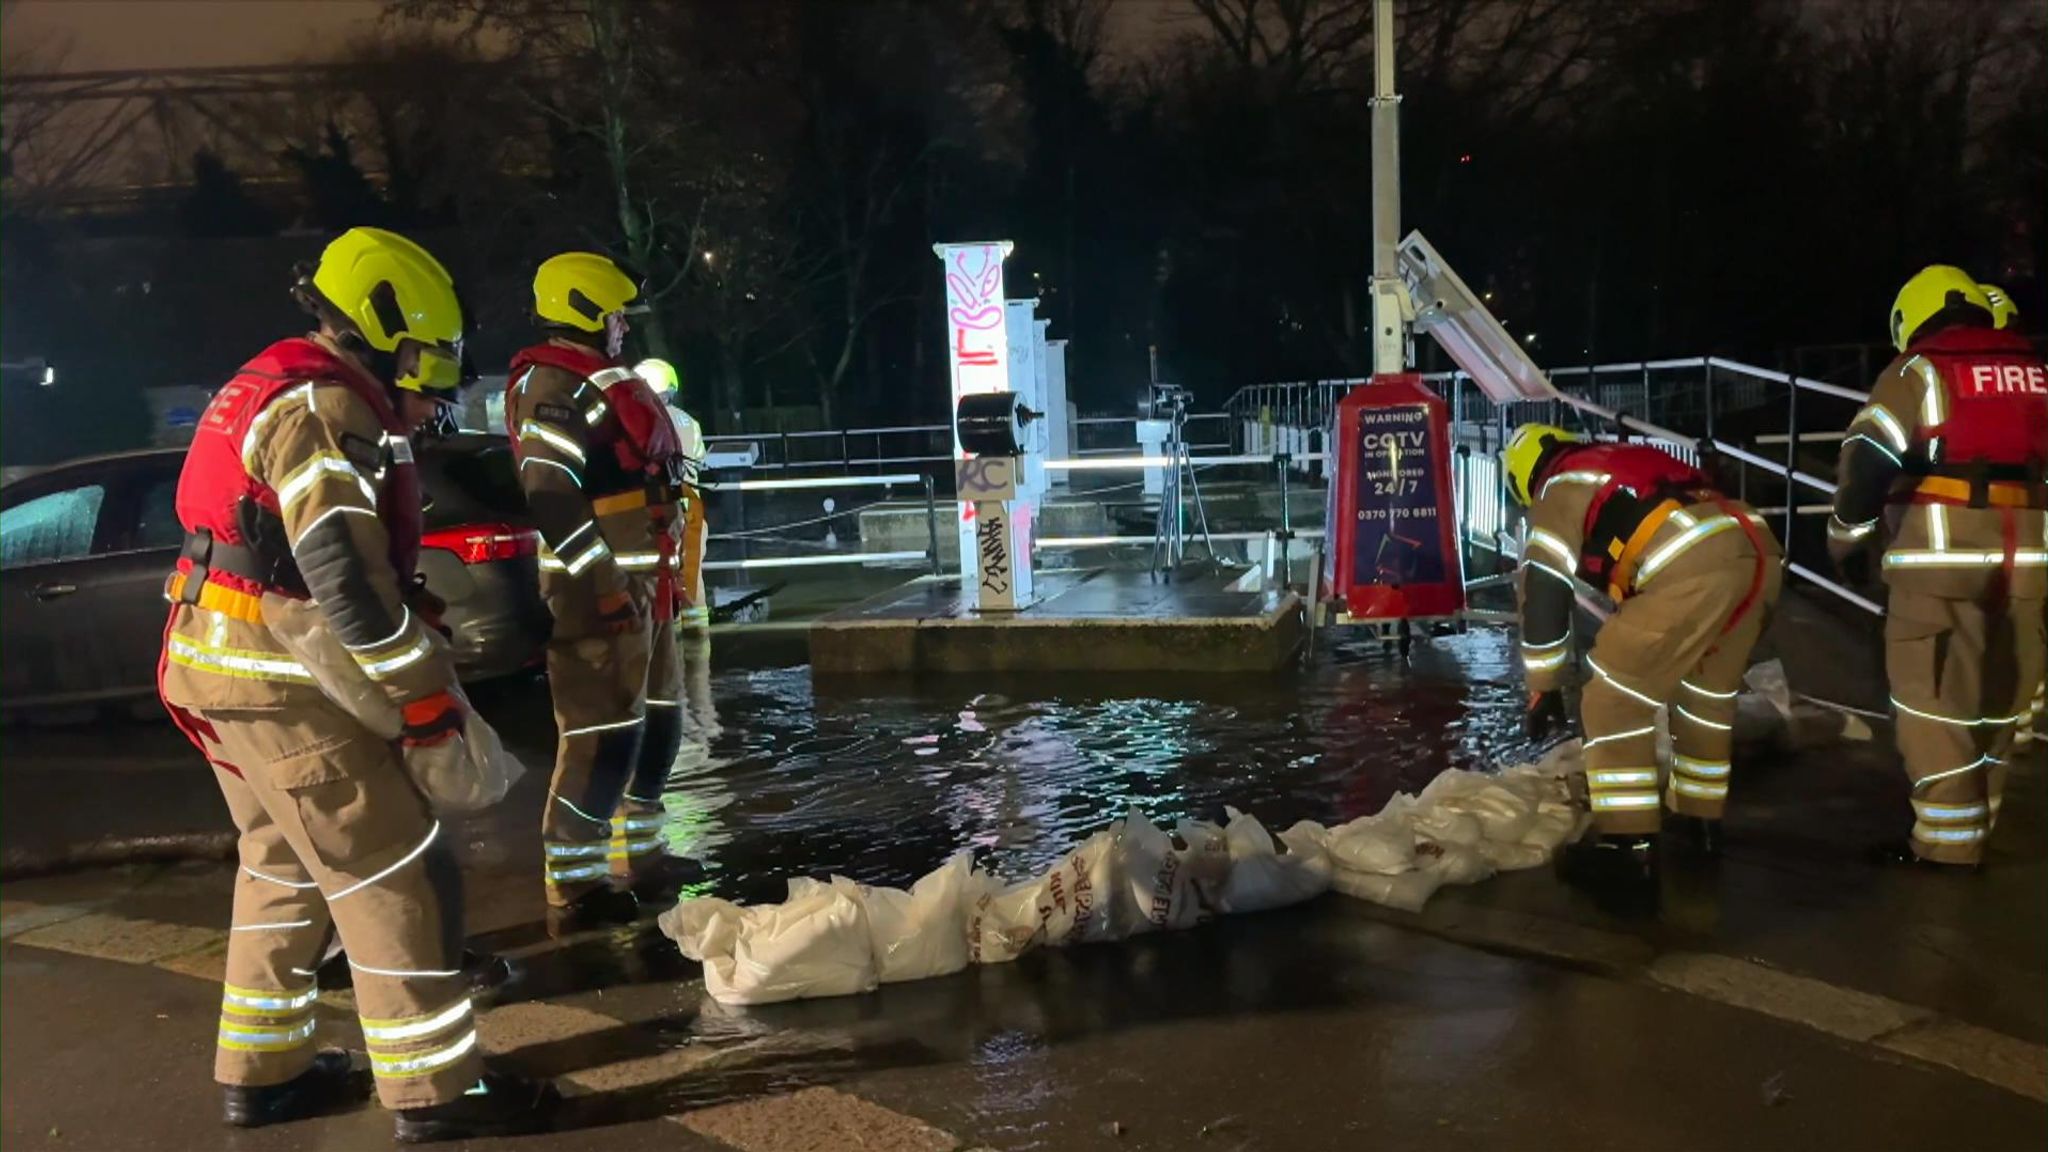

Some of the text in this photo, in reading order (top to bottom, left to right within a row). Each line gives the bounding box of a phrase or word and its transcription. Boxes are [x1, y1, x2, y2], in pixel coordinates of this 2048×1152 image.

[1971, 364, 2048, 395] FIRE
[1365, 412, 1422, 424] WARNING
[1364, 431, 1424, 449] CCTV
[1374, 478, 1418, 496] 24/7
[1358, 509, 1386, 520] 0370
